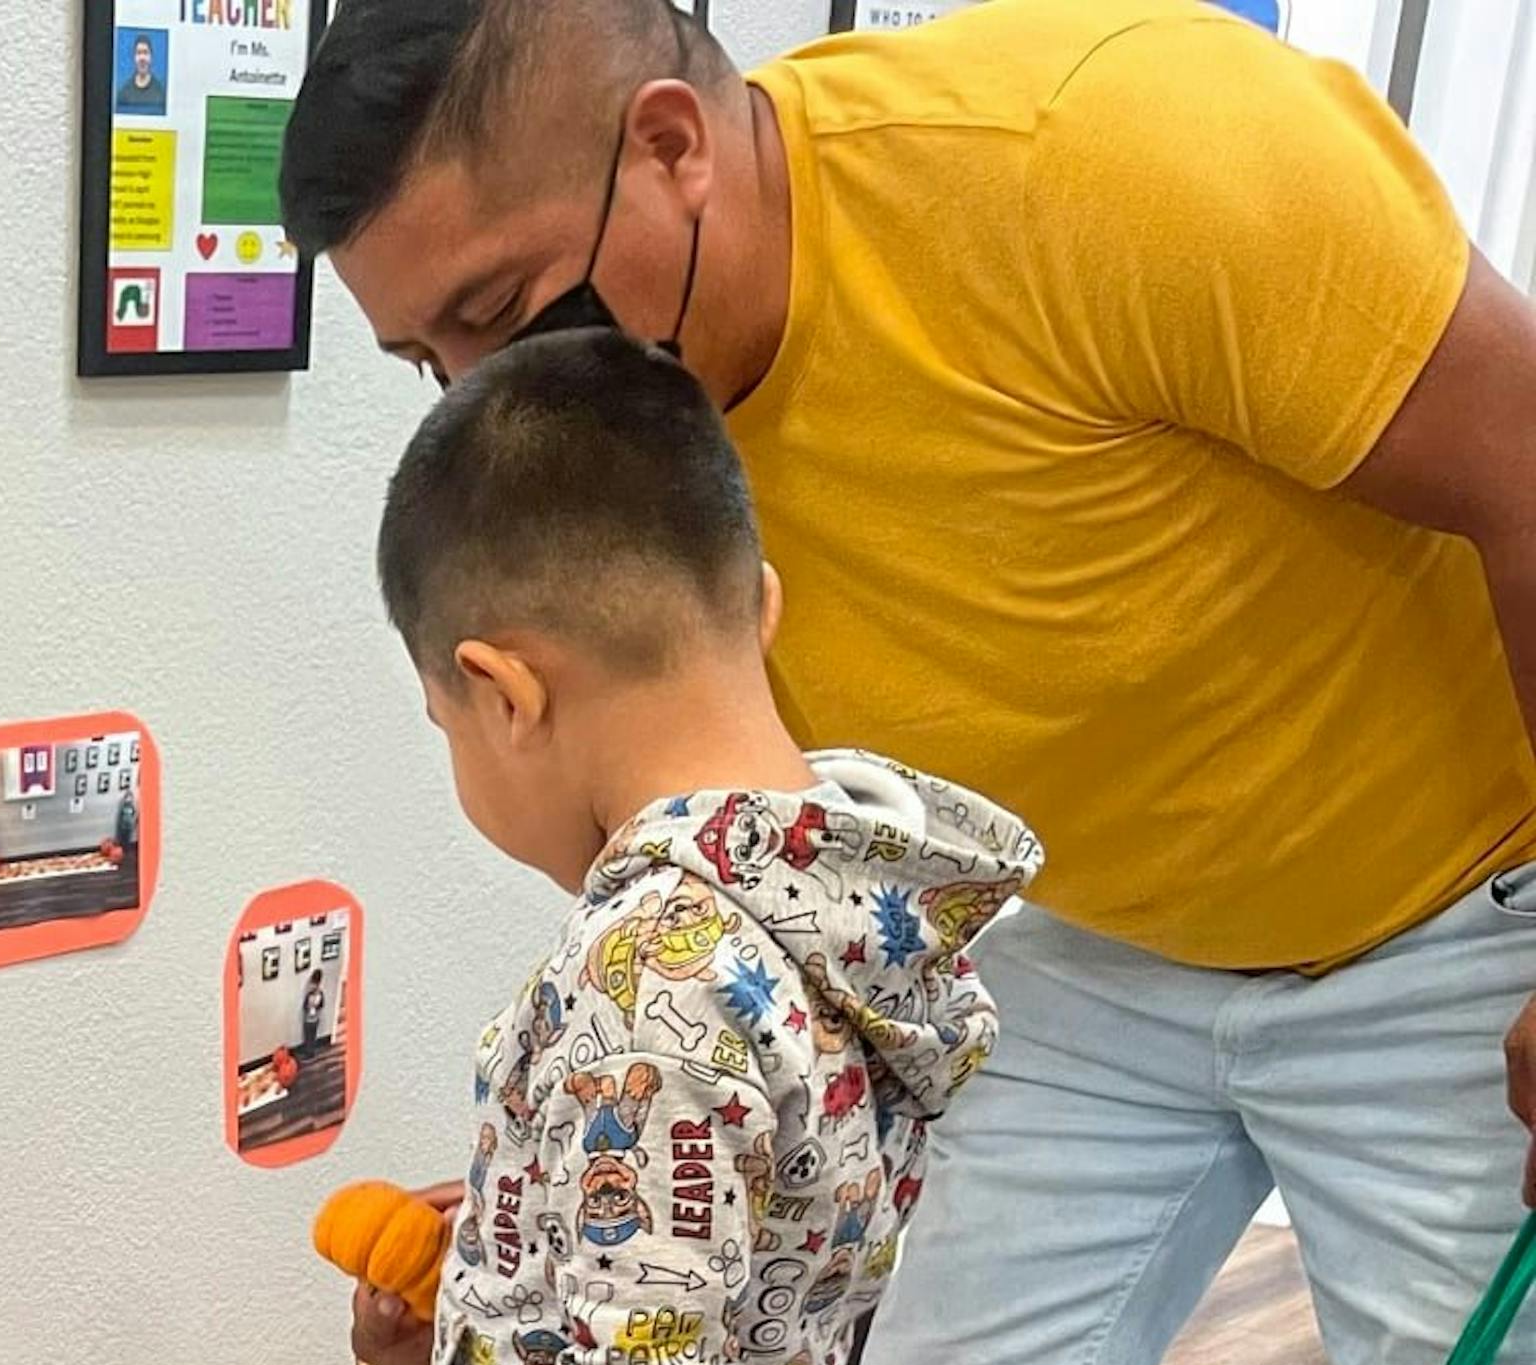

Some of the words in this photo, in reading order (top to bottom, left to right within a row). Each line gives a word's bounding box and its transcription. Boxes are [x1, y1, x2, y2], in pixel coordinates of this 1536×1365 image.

[230, 68, 287, 85] Antoinette
[231, 40, 248, 56] I'm
[251, 41, 270, 57] Ms.
[671, 1115, 713, 1240] LEADER
[494, 1174, 524, 1279] LEADER
